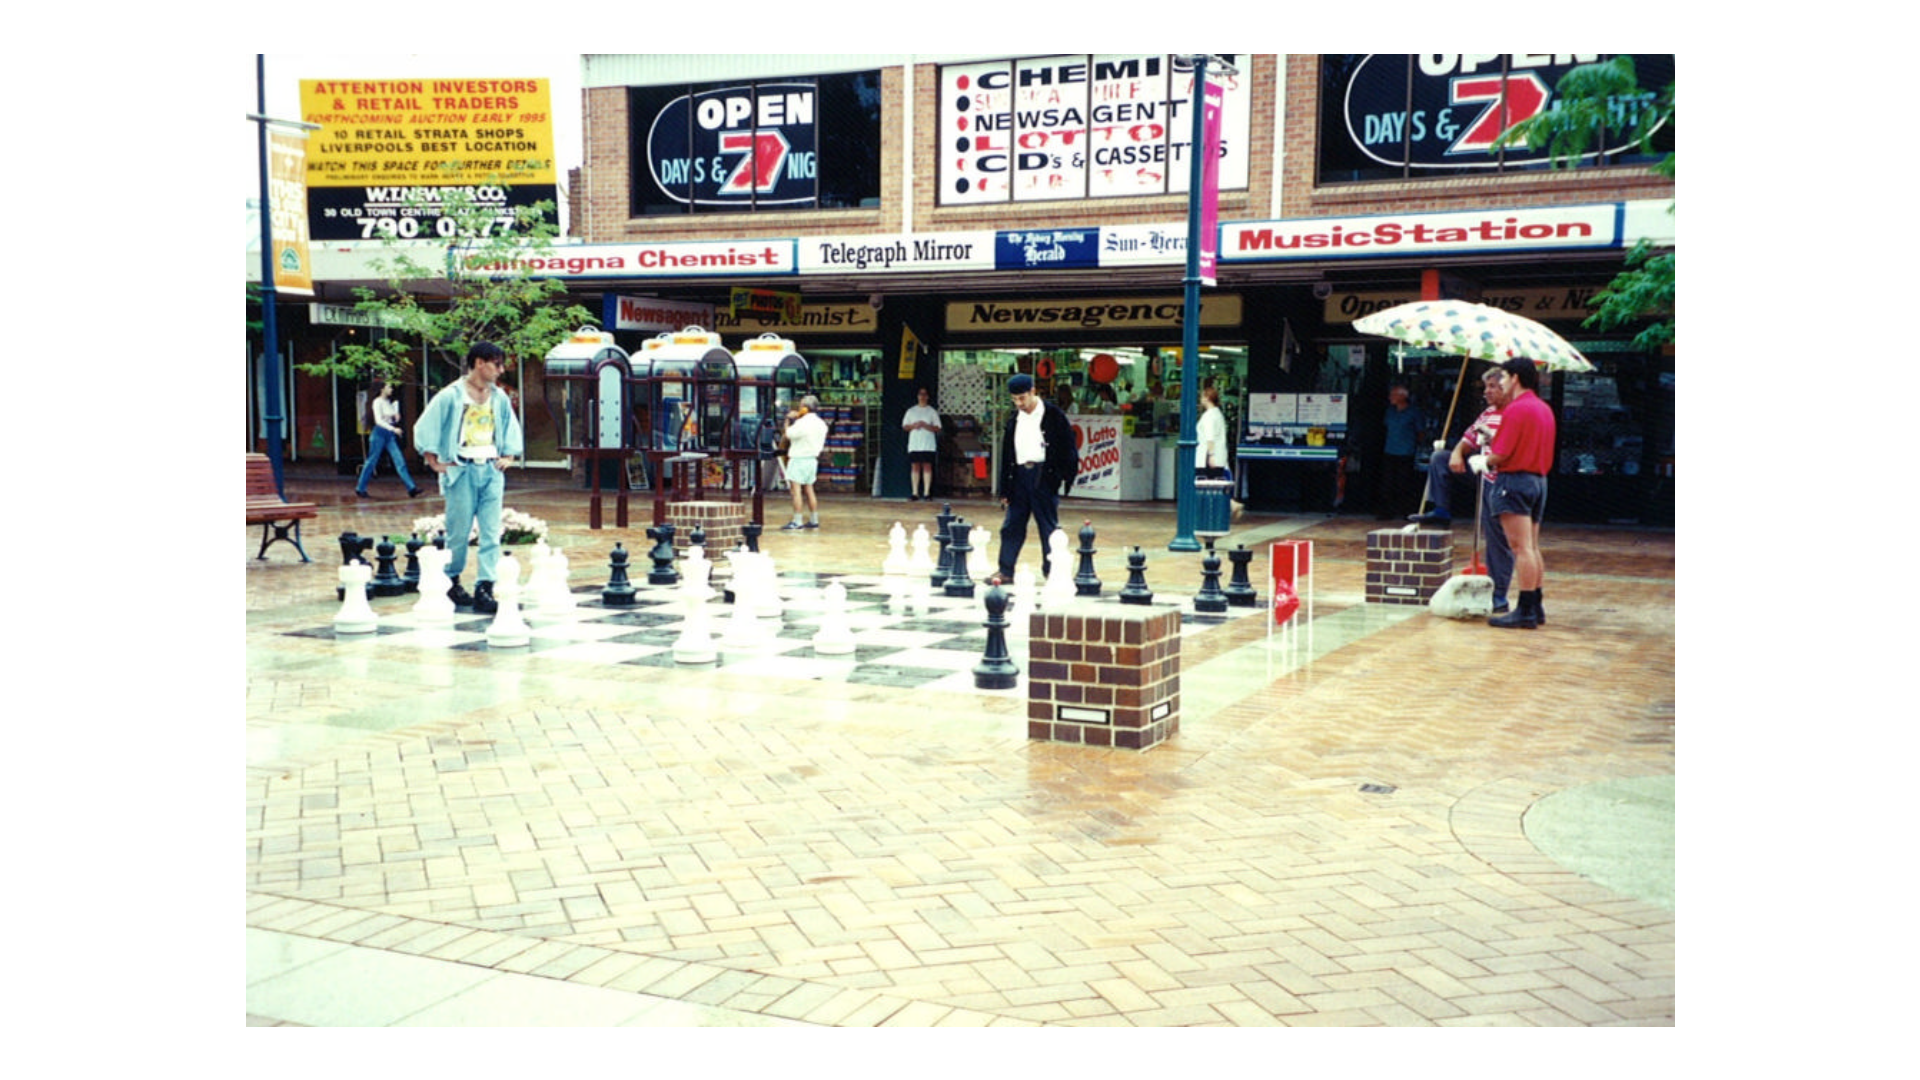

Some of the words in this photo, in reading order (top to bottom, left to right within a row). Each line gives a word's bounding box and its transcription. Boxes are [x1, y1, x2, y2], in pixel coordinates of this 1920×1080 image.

[315, 82, 423, 94] ATTENTION
[433, 80, 538, 94] INVESTORS
[333, 98, 345, 110] &
[357, 98, 422, 111] RETAIL
[433, 96, 519, 109] TRADERS
[697, 92, 813, 130] OPEN
[1443, 70, 1551, 156] 7
[306, 114, 403, 124] FORTHCOMING
[409, 113, 467, 123] AUCTION
[472, 112, 513, 123] EARLY
[519, 112, 546, 122] 1995
[975, 99, 1188, 132] NEWSAGENT
[1435, 109, 1460, 141] &
[334, 130, 348, 139] 10
[355, 129, 406, 139] RETAIL
[414, 129, 469, 138] STRATA
[476, 129, 524, 138] SHOPS
[1364, 111, 1426, 145] DAYS
[321, 143, 414, 153] LIVERPOOLS
[421, 142, 457, 152] BEST
[465, 142, 537, 151] LOCATION
[307, 161, 346, 171] WATCH
[353, 161, 377, 170] THIS
[383, 161, 419, 171] SPACE
[450, 160, 502, 170] URTHER
[661, 157, 705, 185] DAYS
[711, 157, 727, 183] &
[717, 128, 791, 195] 7
[1072, 153, 1085, 169] &
[340, 207, 363, 217] OLD
[367, 207, 397, 217] TOWN
[400, 207, 441, 217] CENTRE
[357, 217, 419, 239] 790
[1238, 218, 1592, 251] MusicStation
[638, 247, 779, 267] Chemist
[820, 242, 907, 269] Telegraph
[912, 239, 972, 262] Mirror
[1024, 243, 1066, 265] Herald
[620, 298, 712, 328] Newsagent
[1341, 295, 1410, 319] Ope
[1087, 426, 1117, 444] Lotto
